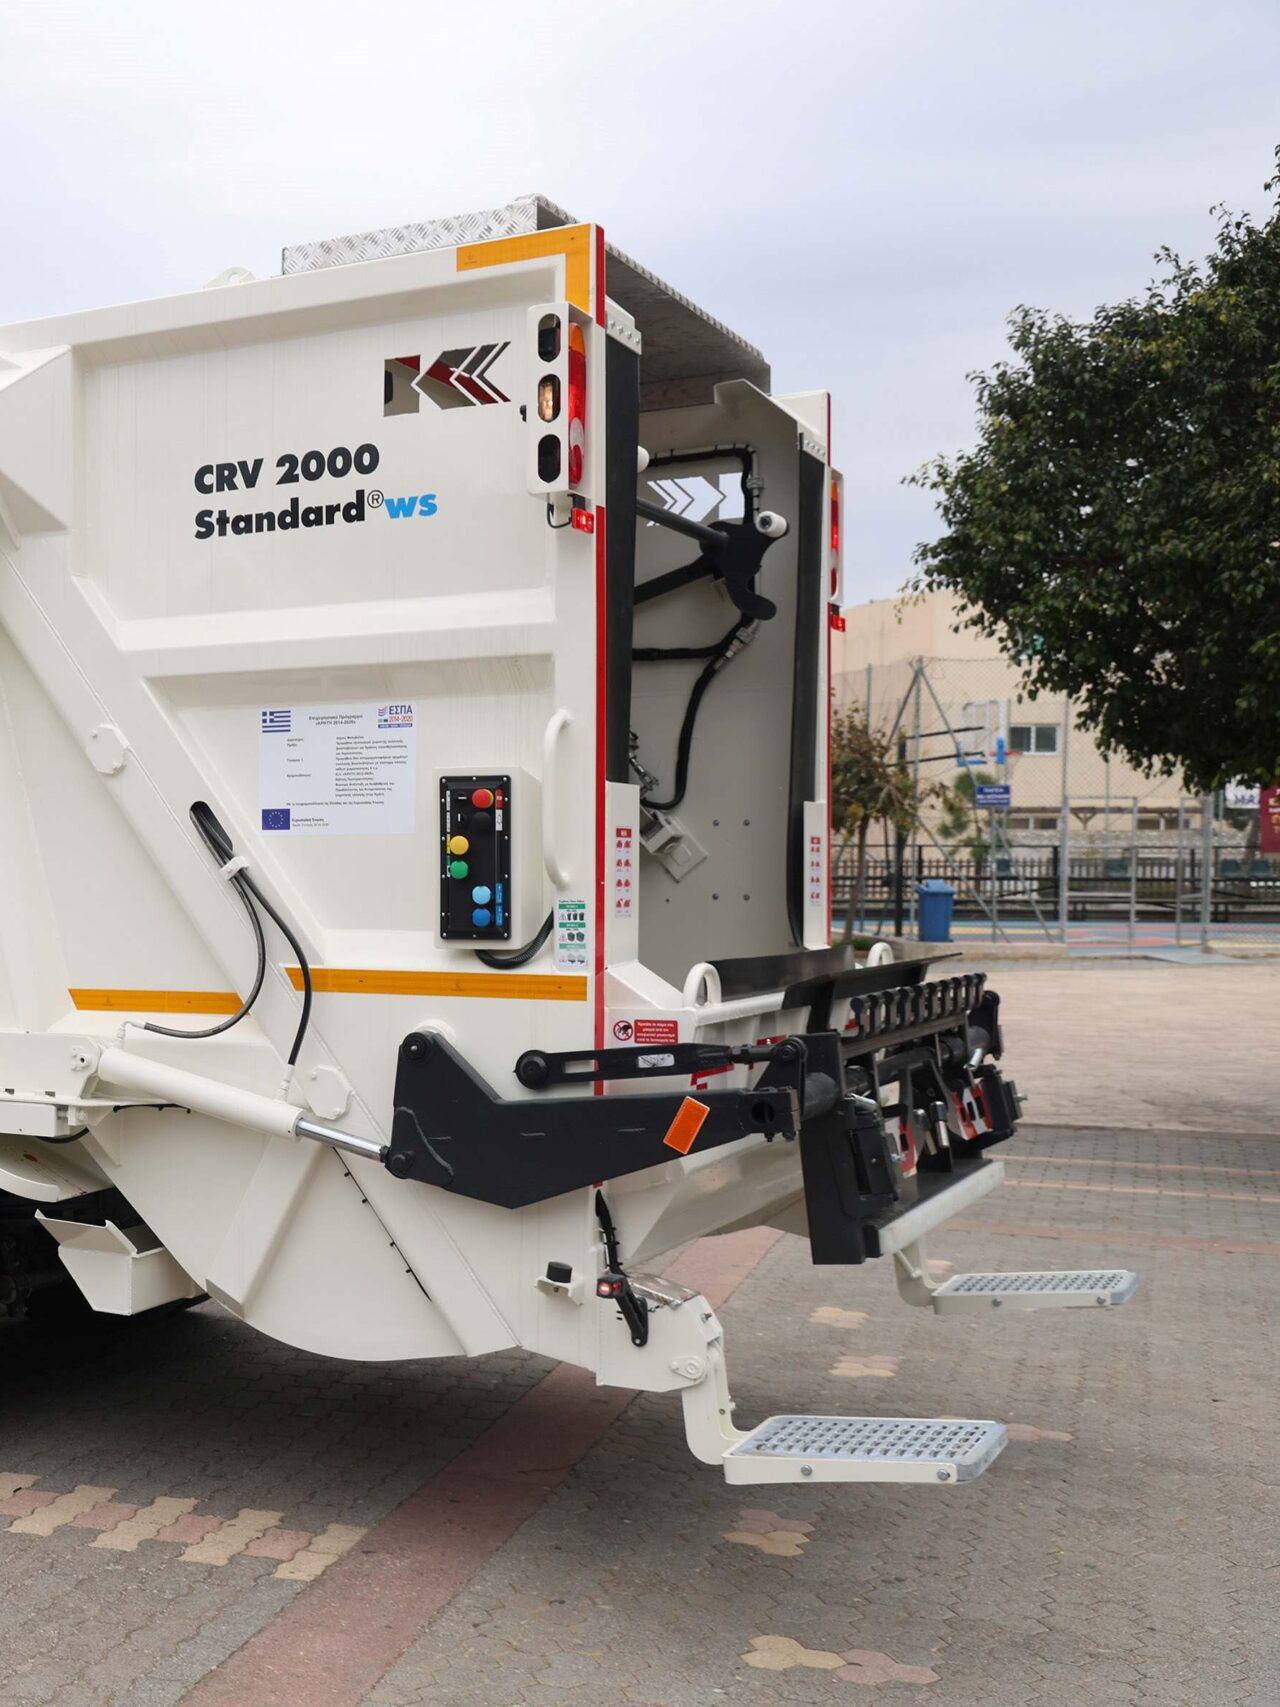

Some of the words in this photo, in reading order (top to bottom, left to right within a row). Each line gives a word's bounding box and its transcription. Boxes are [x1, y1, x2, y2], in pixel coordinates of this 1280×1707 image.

[194, 458, 264, 494] CRV
[275, 443, 380, 485] 2000
[389, 705, 413, 715] ΕΣΠΑ
